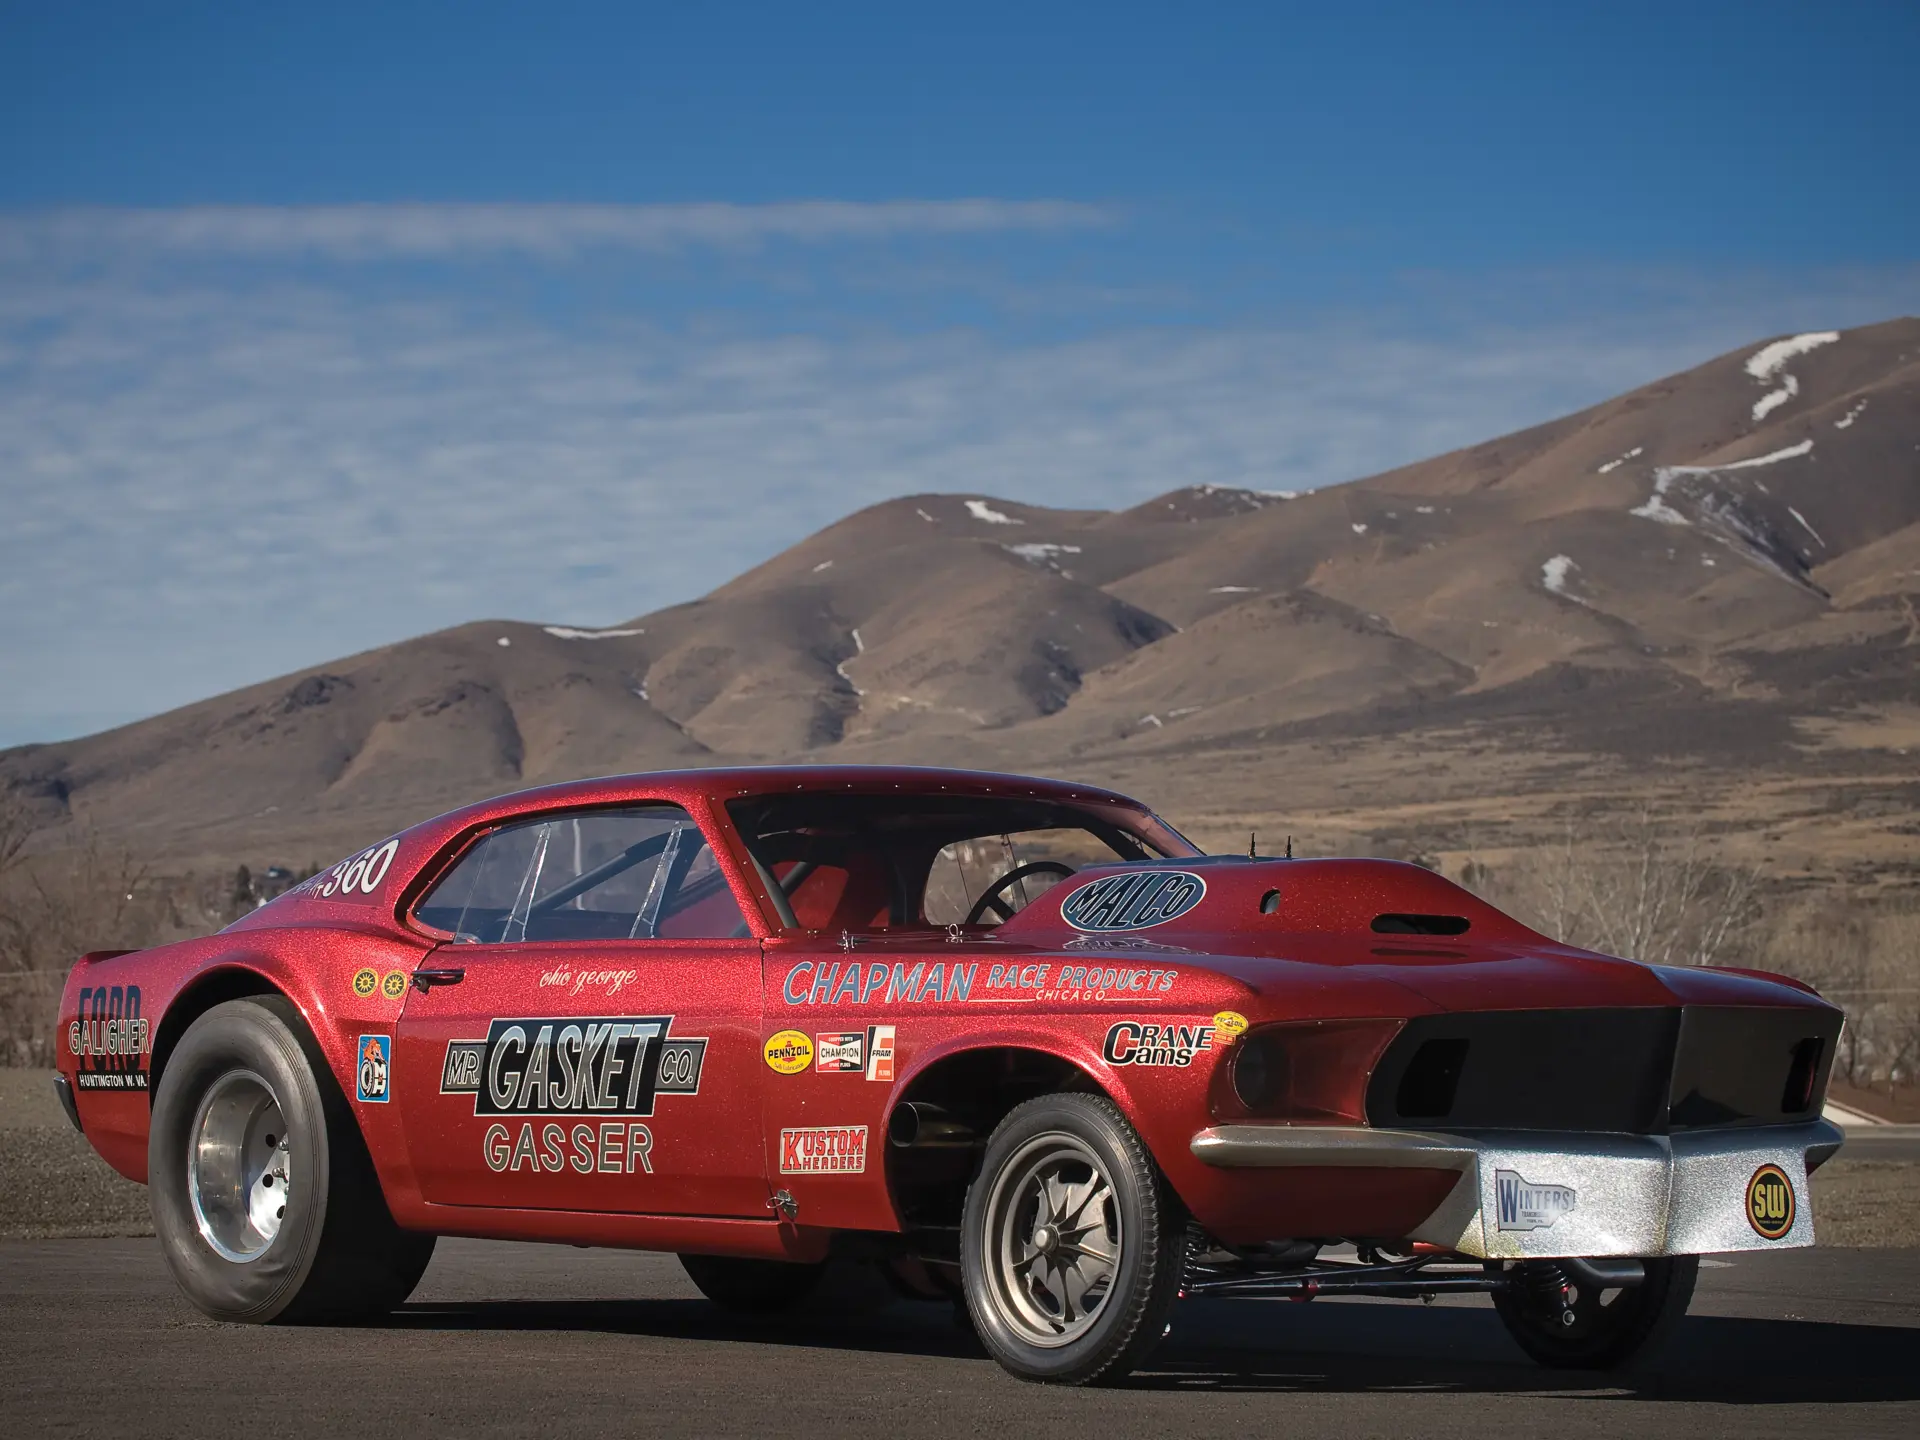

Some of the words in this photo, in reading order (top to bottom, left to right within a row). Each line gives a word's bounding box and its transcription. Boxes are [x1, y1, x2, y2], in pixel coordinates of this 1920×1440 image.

[322, 839, 400, 897] 360
[1066, 873, 1197, 928] MALCO
[569, 969, 638, 996] george
[783, 961, 979, 1004] CHAPMAN
[986, 964, 1051, 989] RACE
[1057, 965, 1178, 991] PRODUCTS
[1035, 989, 1106, 1001] CHICAGO
[68, 1018, 150, 1056] GALIGHER
[78, 985, 142, 1074] FORD
[1103, 1021, 1216, 1067] CRANE
[447, 1050, 480, 1084] MR.
[488, 1023, 661, 1110] GASKET
[659, 1048, 694, 1083] CO.
[768, 1045, 810, 1060] PENNZOIL
[820, 1047, 859, 1058] CHAMPION
[871, 1049, 892, 1057] FRAM
[79, 1074, 124, 1087] HUNTINGTON
[125, 1074, 135, 1086] W.
[137, 1074, 147, 1086] VA.
[483, 1123, 654, 1174] GASSER
[782, 1130, 866, 1170] KUSTOM
[802, 1156, 863, 1170] HEADERS
[1499, 1179, 1570, 1222] WINTERS
[1754, 1183, 1785, 1218] SW
